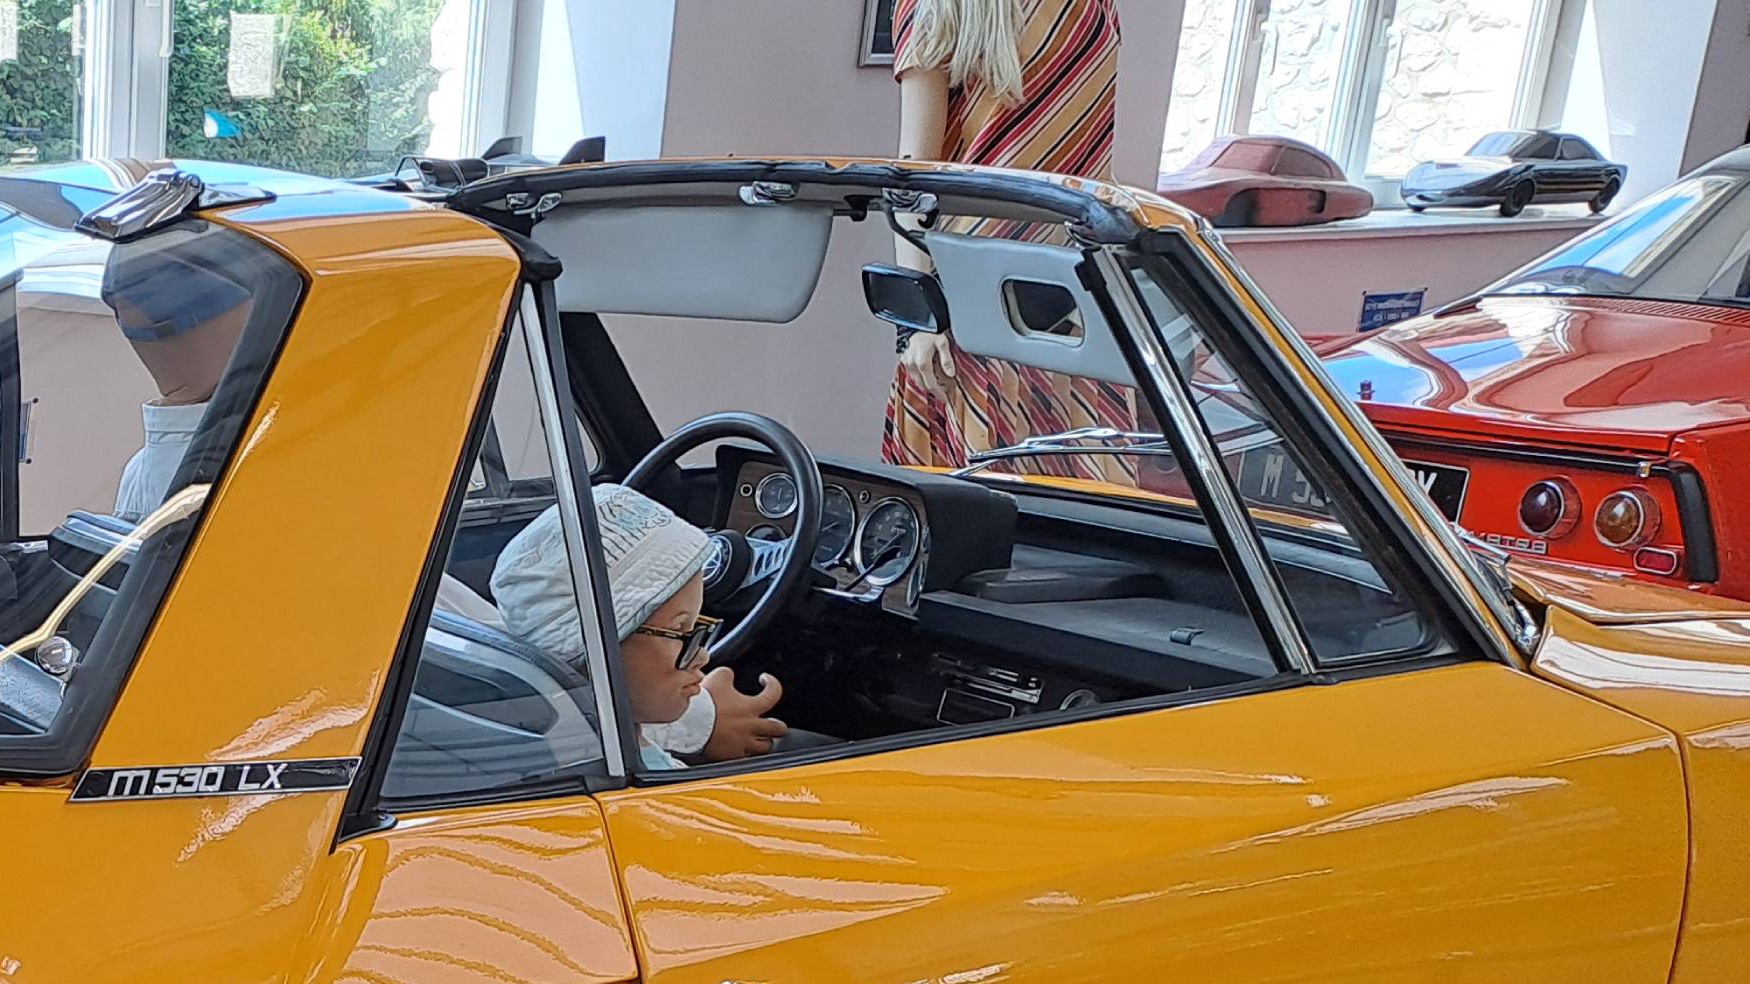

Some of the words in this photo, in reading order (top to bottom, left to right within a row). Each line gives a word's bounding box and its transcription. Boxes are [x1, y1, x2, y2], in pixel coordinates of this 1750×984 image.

[1260, 453, 1285, 498] M
[1471, 531, 1547, 555] ATRA
[238, 763, 288, 791] LX
